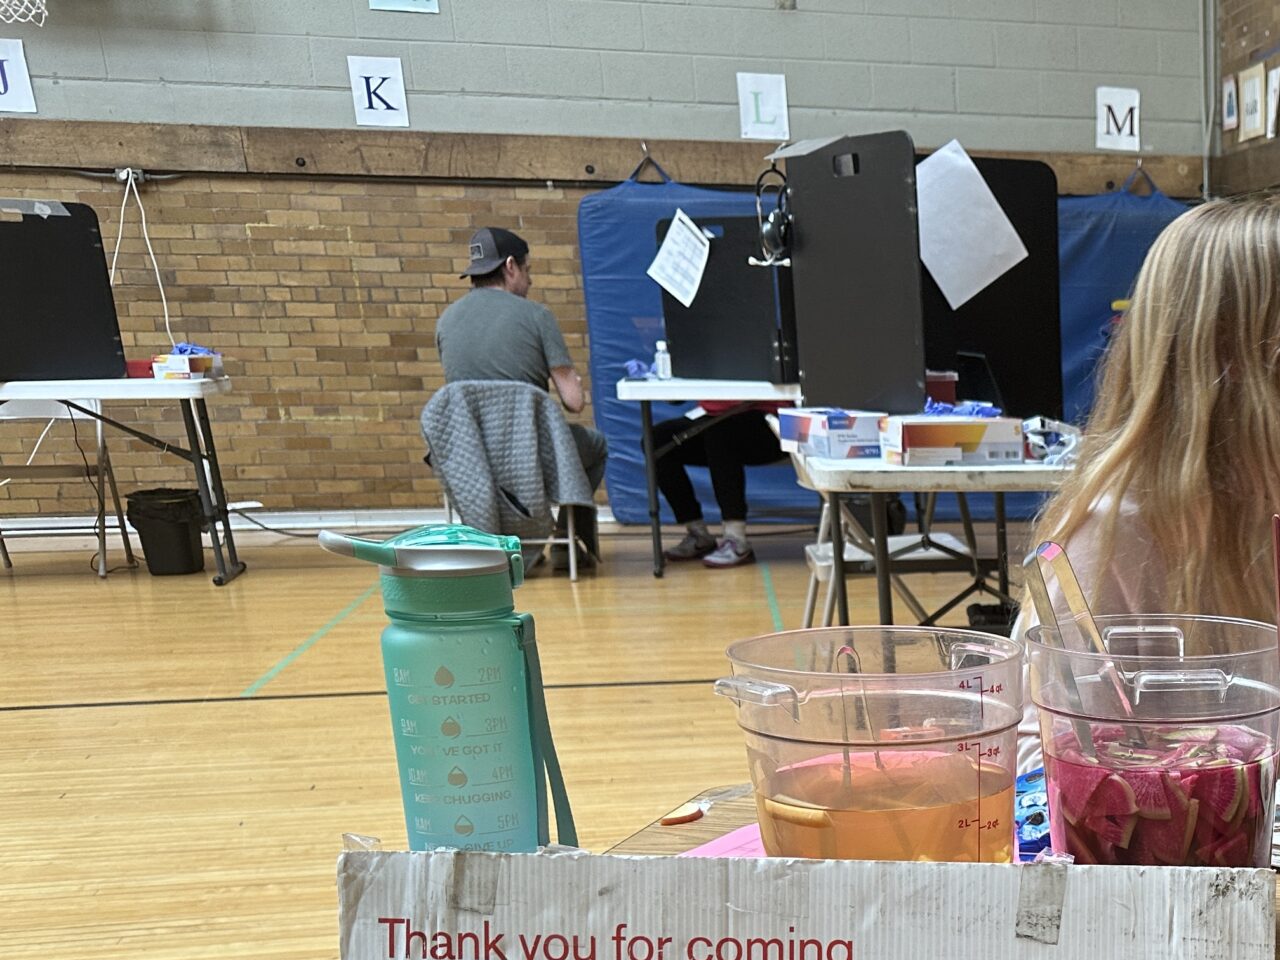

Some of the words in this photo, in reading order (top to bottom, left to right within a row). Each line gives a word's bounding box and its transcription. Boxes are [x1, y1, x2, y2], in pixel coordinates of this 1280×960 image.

[359, 76, 399, 111] K
[750, 91, 777, 125] L
[1103, 104, 1136, 137] M
[478, 666, 502, 683] 2PM
[958, 680, 972, 689] 4L
[431, 693, 491, 706] STARTED
[485, 717, 508, 733] 3PM
[462, 744, 489, 756] GOT
[493, 742, 503, 753] IT
[957, 742, 971, 751] 3L
[492, 764, 513, 781] 4PM
[444, 791, 512, 805] CHUGGING
[498, 812, 519, 830] 5PM
[958, 819, 971, 829] 2L
[378, 918, 507, 960] Thank
